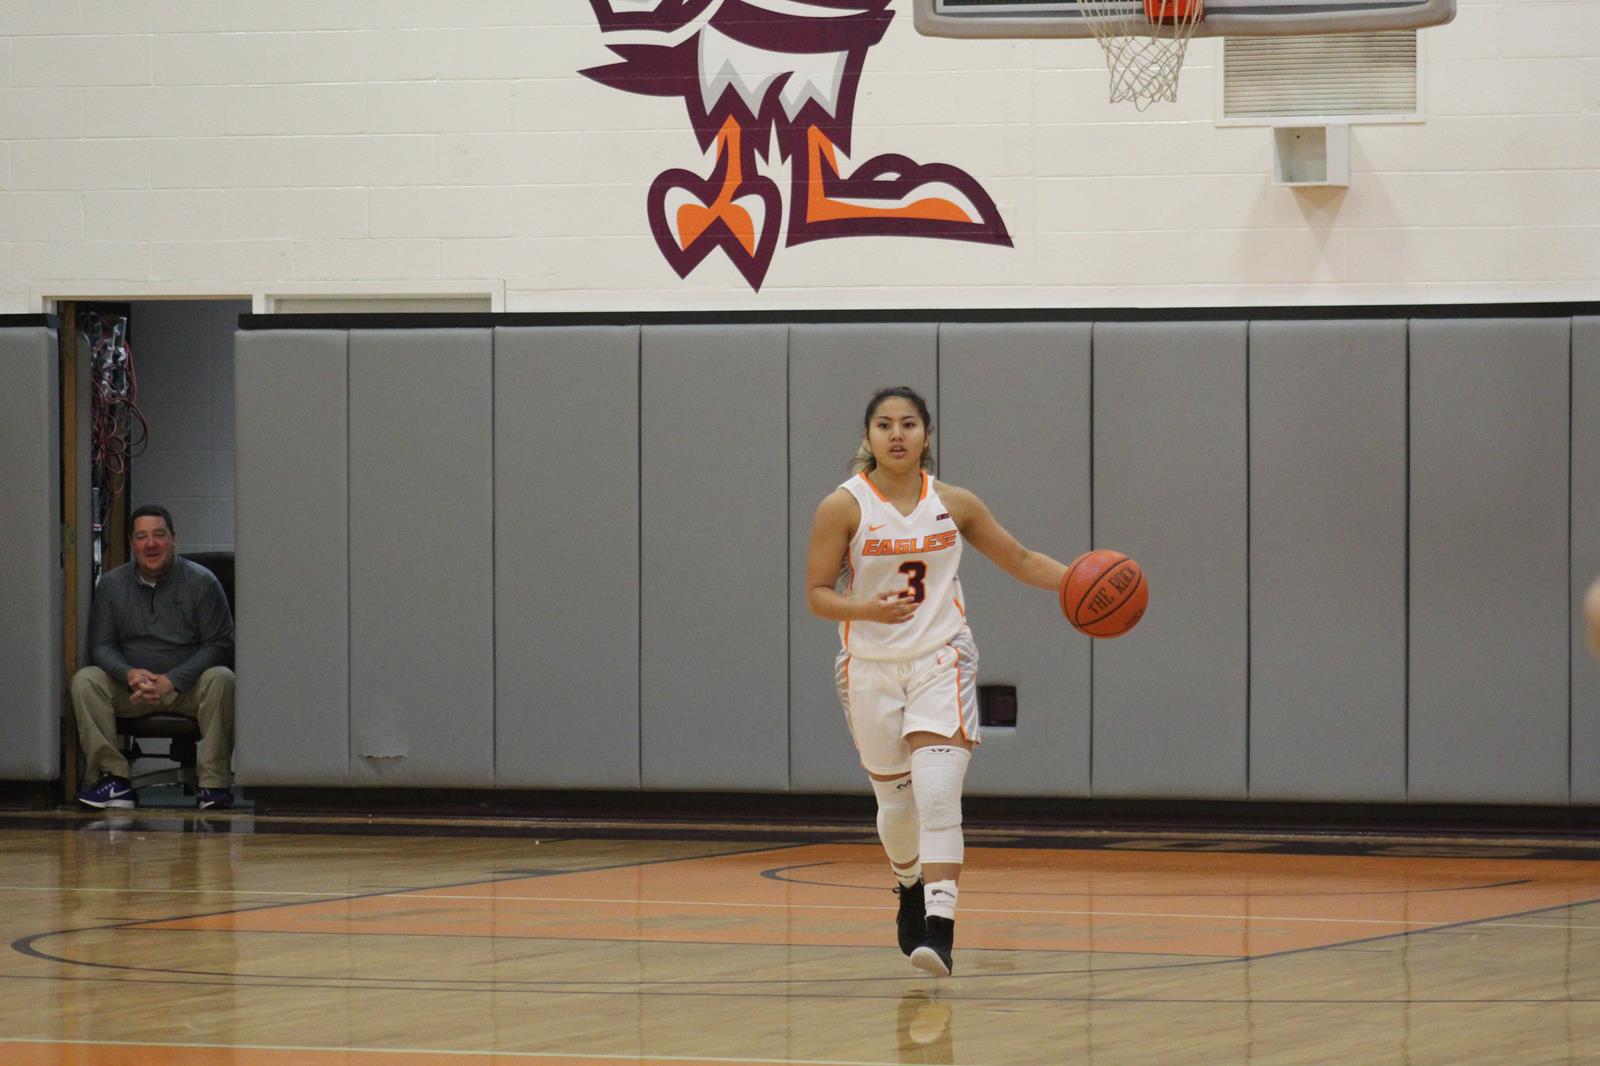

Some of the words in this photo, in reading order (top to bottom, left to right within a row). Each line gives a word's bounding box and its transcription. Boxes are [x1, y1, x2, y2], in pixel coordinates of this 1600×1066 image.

[862, 530, 957, 556] EAGLES
[898, 560, 926, 603] 3
[1087, 587, 1115, 614] THE
[1108, 566, 1137, 594] ROCK
